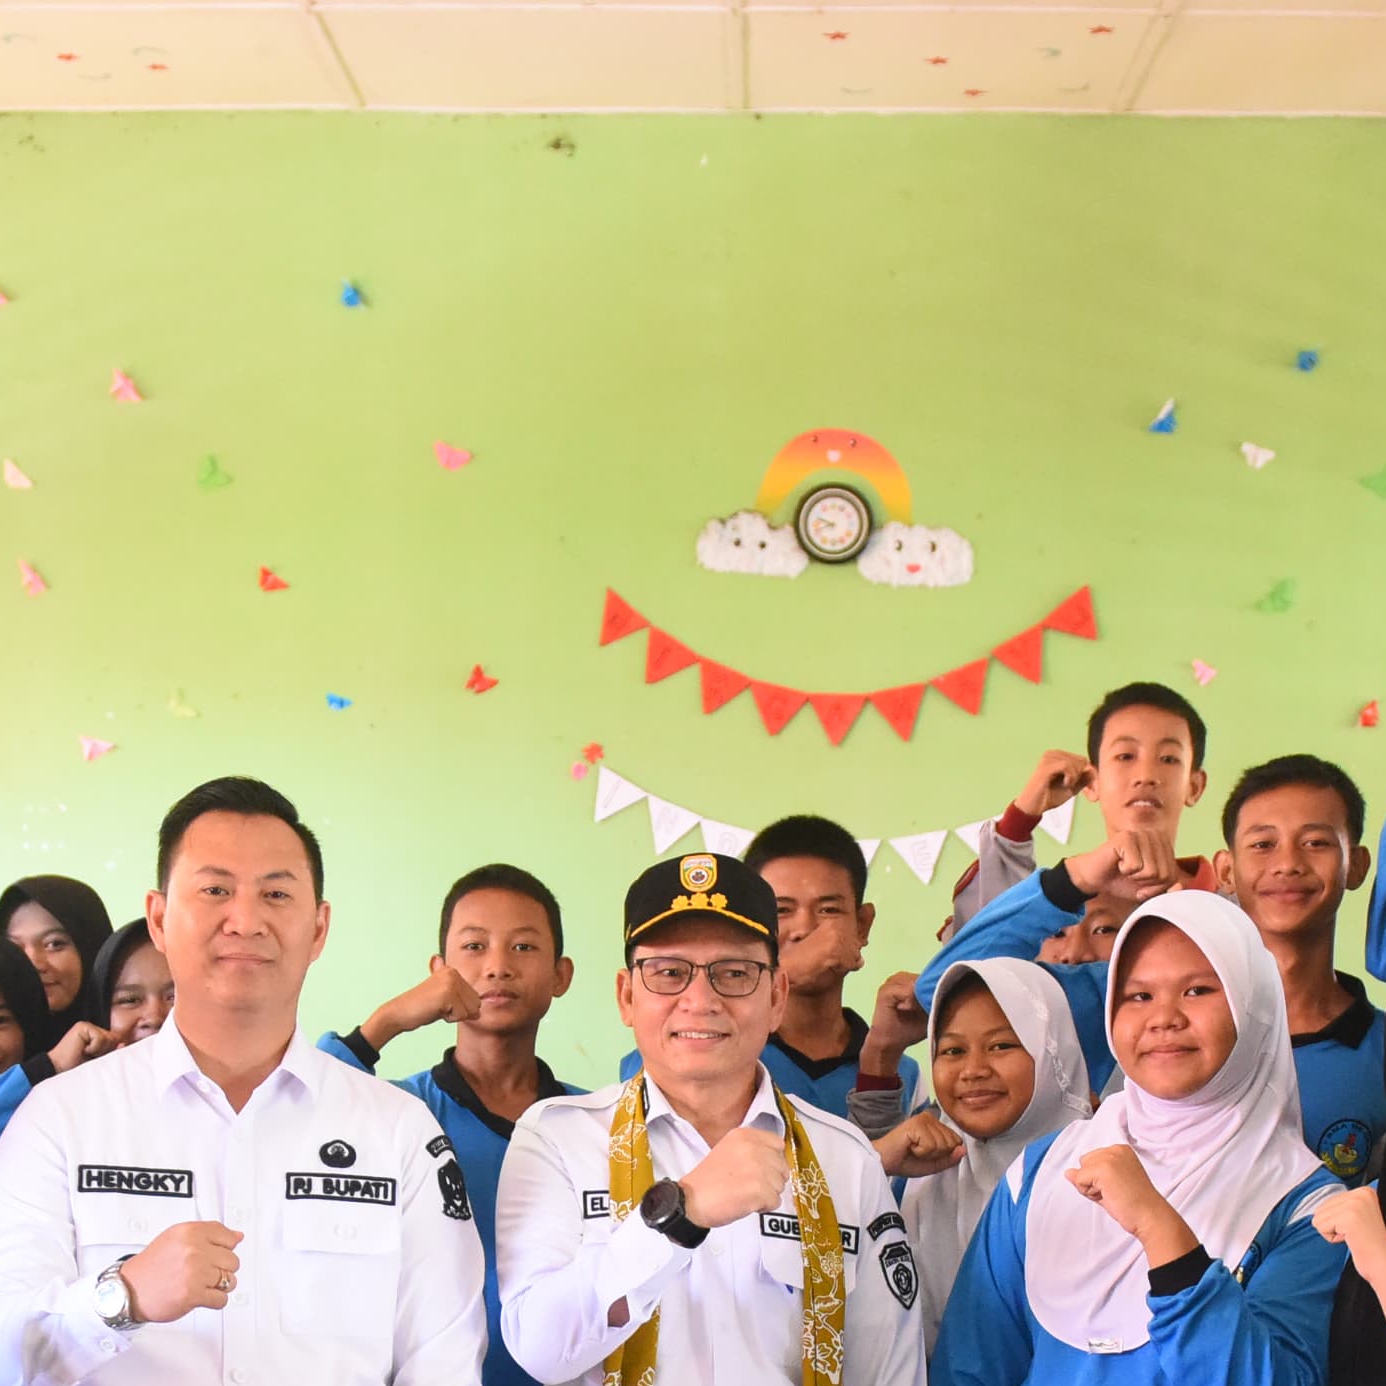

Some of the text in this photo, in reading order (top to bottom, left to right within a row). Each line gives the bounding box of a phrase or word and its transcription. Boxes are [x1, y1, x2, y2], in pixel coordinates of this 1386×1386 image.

[86, 1170, 186, 1192] HENGKY
[294, 1178, 389, 1200] PJ BUPATI
